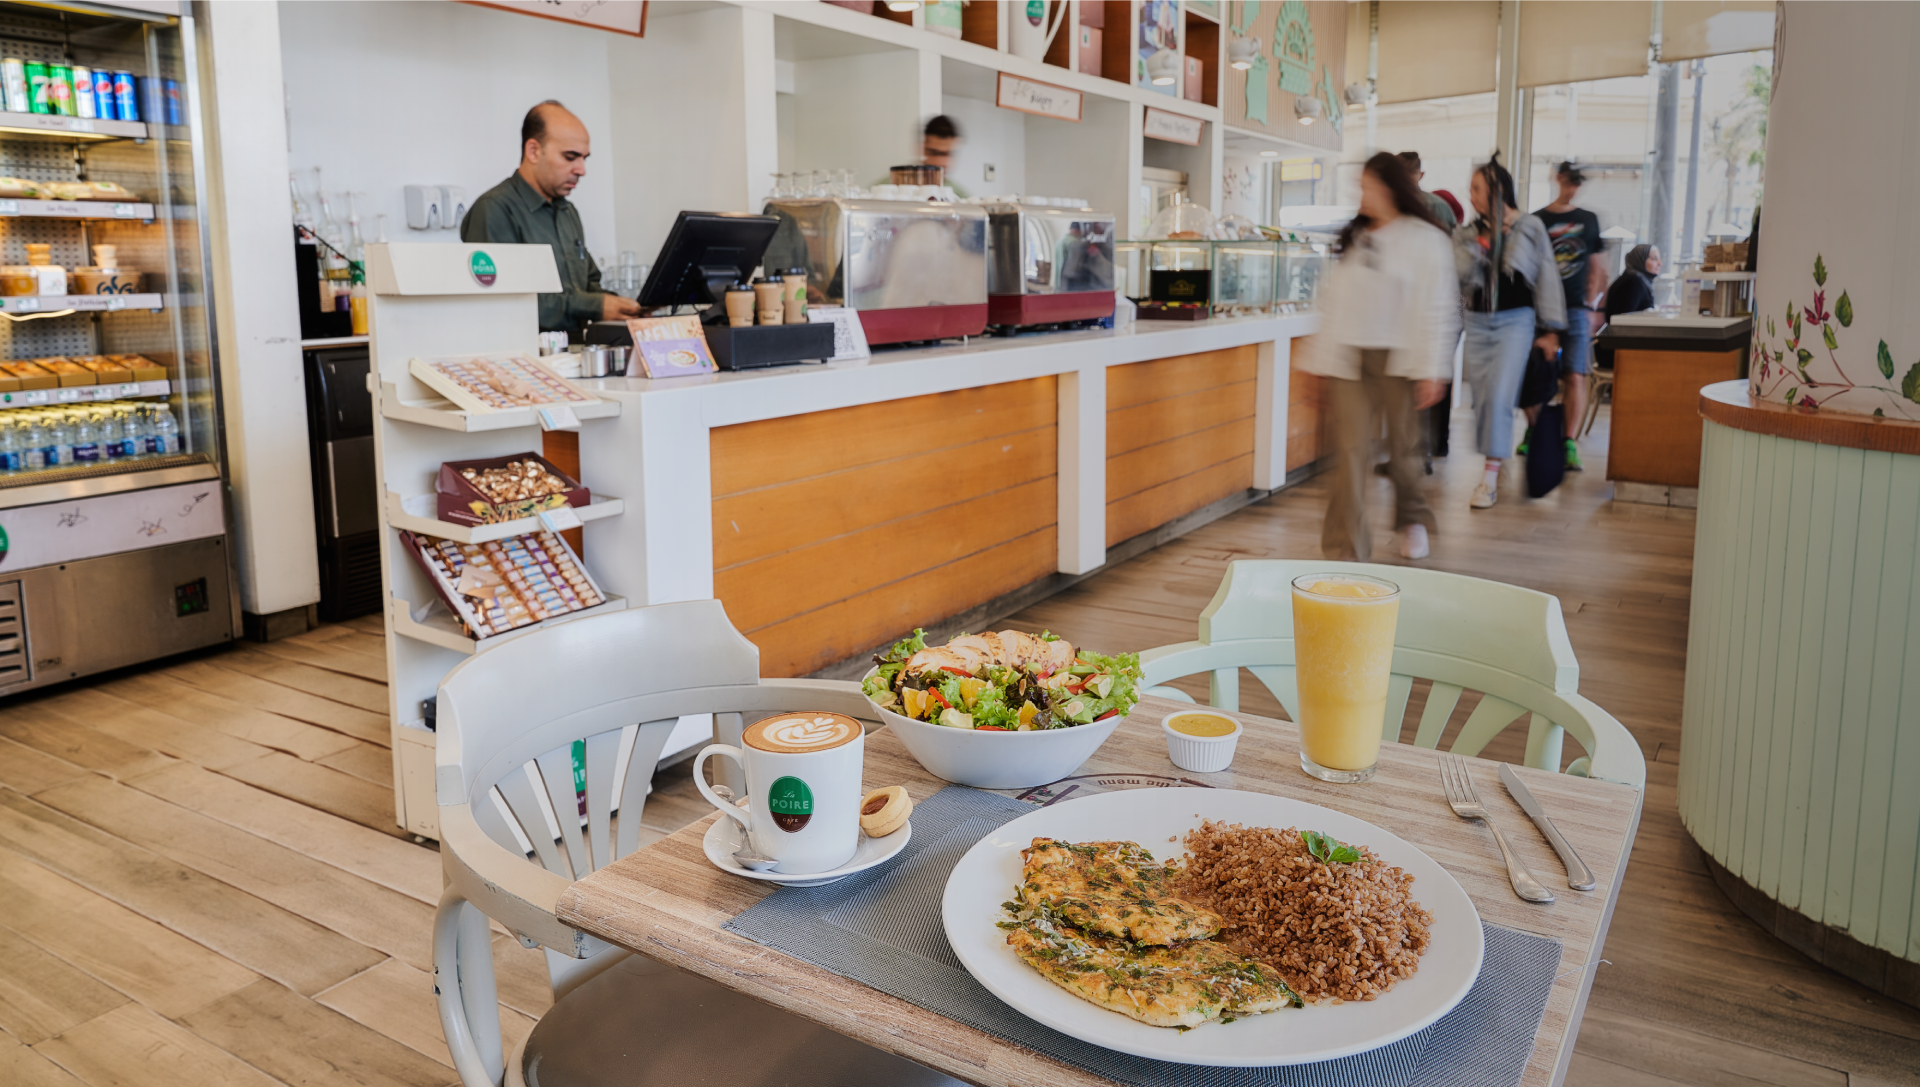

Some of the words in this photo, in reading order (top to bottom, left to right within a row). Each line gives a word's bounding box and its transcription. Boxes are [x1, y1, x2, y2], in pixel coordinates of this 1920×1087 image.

[1097, 778, 1141, 786] menu
[782, 790, 796, 798] La
[772, 798, 810, 810] POIRE
